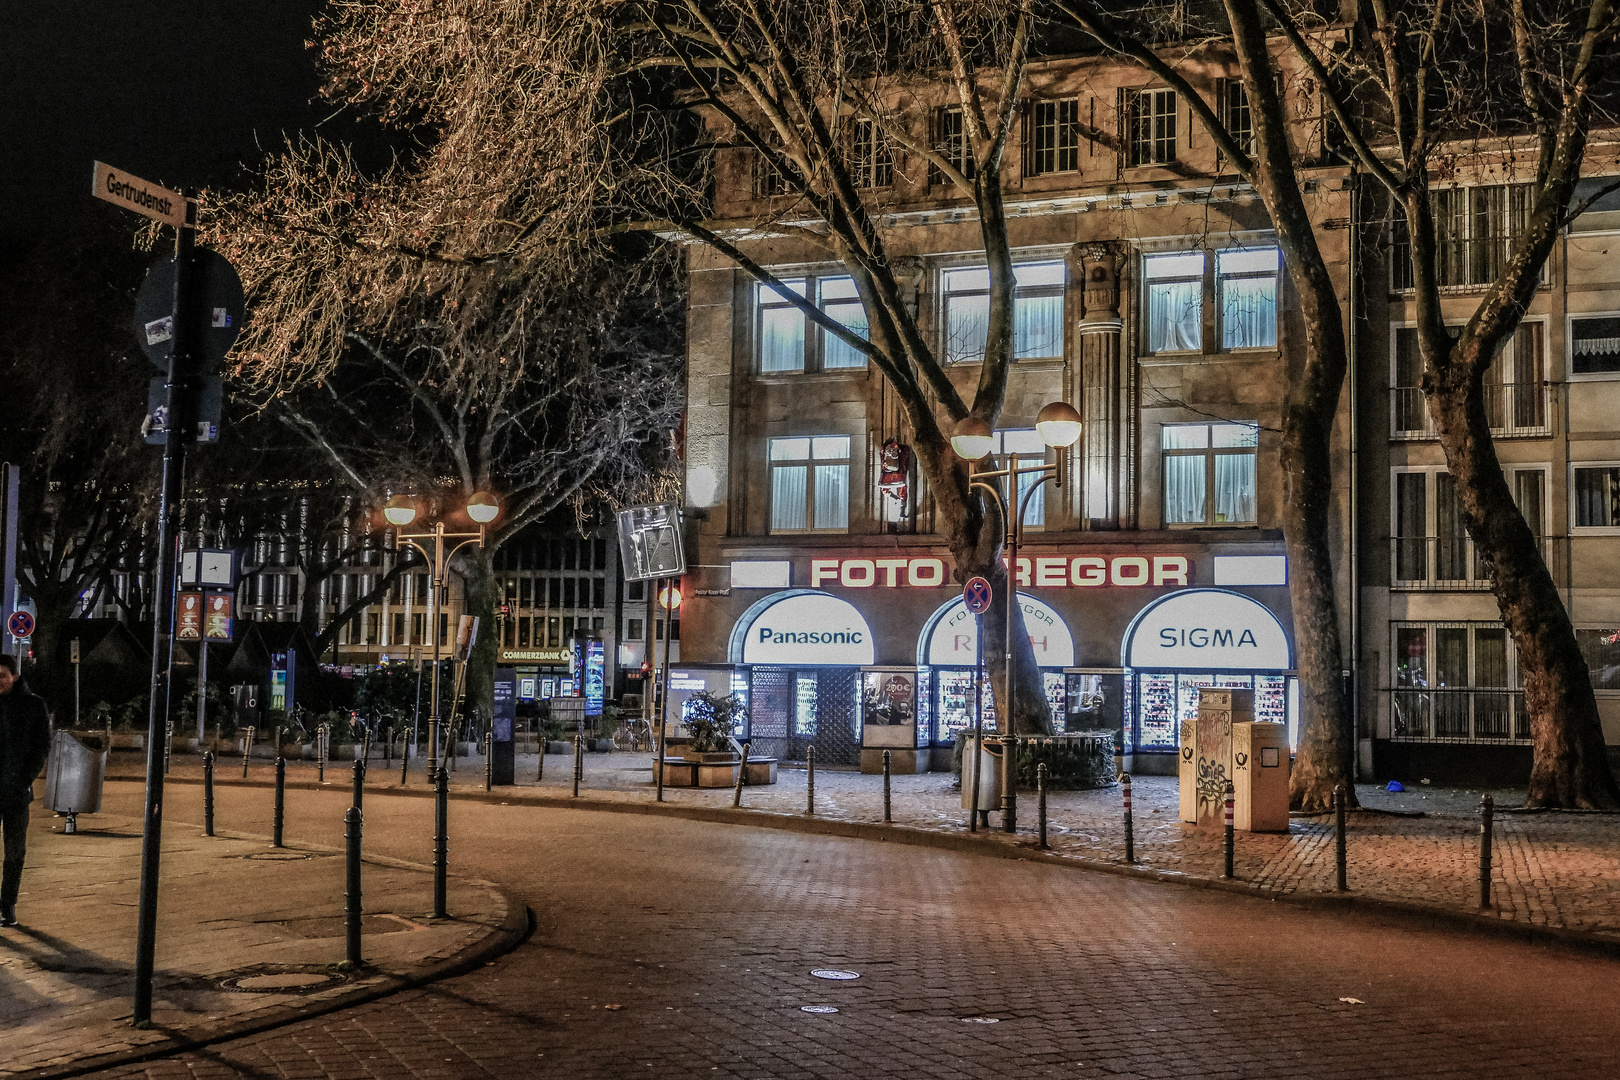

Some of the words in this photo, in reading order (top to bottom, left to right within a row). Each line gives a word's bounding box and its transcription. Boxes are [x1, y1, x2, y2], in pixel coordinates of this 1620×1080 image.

[107, 172, 174, 218] Gertrudenstr.
[811, 558, 944, 588] FOTO
[1002, 556, 1188, 587] REGOR
[759, 627, 863, 644] Panasonic
[1159, 627, 1258, 648] SIGMA
[502, 651, 560, 660] COMMERZBANK
